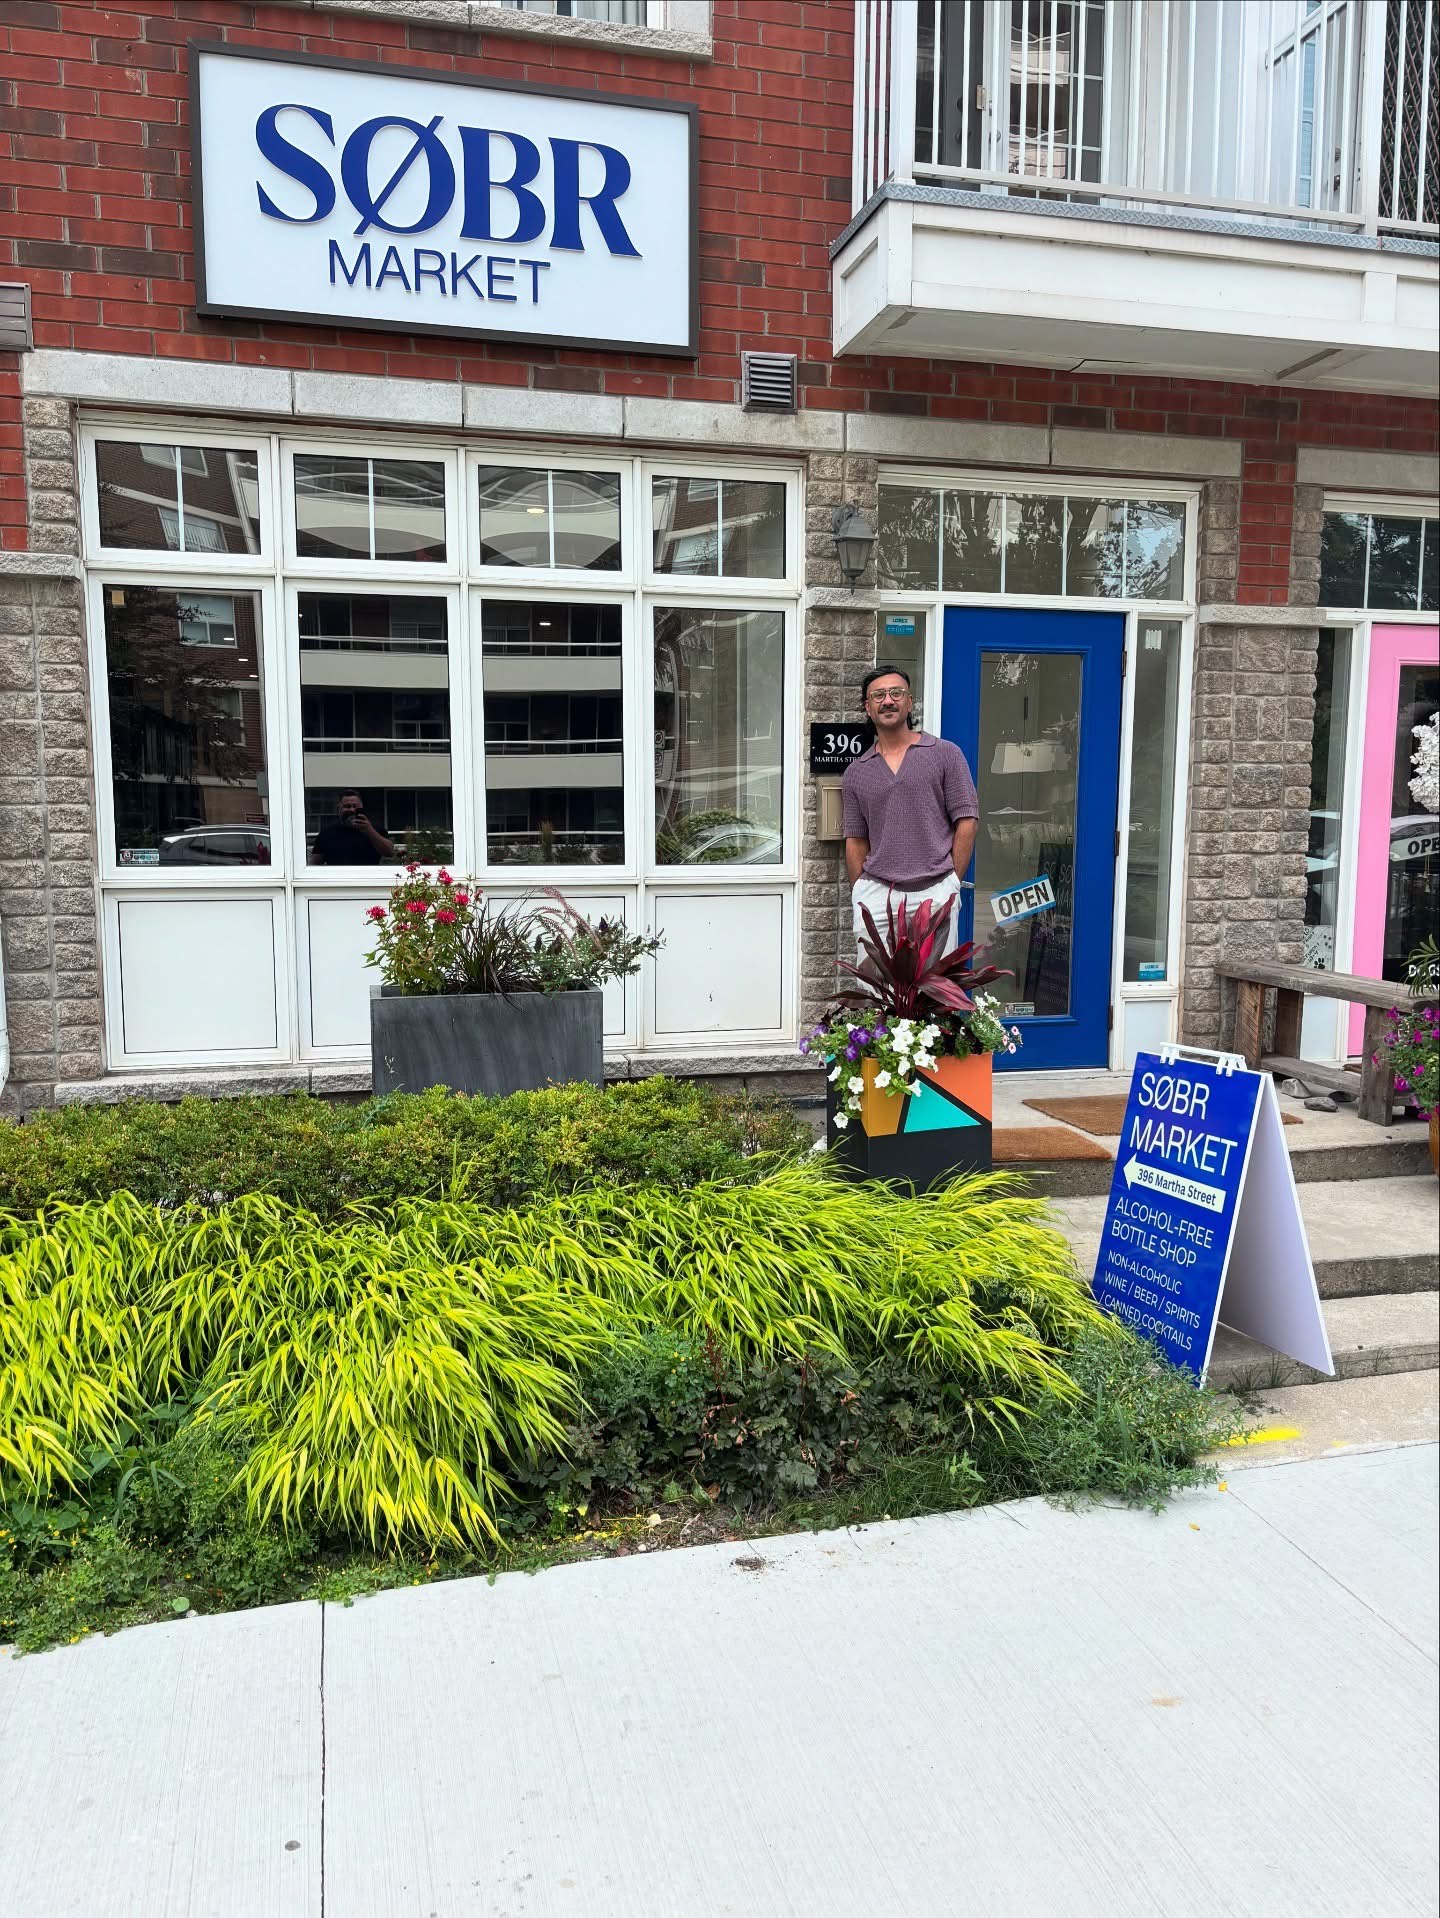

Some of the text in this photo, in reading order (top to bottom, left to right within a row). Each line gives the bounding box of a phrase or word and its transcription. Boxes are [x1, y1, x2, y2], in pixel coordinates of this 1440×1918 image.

[256, 103, 643, 258] SØBR
[329, 239, 551, 304] MARKET
[823, 733, 862, 755] 396
[998, 881, 1051, 917] OPEN
[1138, 1072, 1211, 1120] SØBR
[1130, 1115, 1238, 1177] MARKET
[1137, 1168, 1217, 1206] 396 Martha Street
[1111, 1219, 1197, 1268] BOTTLE SHOP
[1114, 1196, 1214, 1249] ALCOHOL-FREE
[1107, 1249, 1182, 1295] NON-ALCOHOLIC
[1104, 1270, 1128, 1293] WINE
[1133, 1285, 1158, 1308] BEER
[1164, 1300, 1201, 1329] SPIRITS
[1104, 1294, 1141, 1323] CANNED
[1141, 1313, 1193, 1351] COCKTAILS
